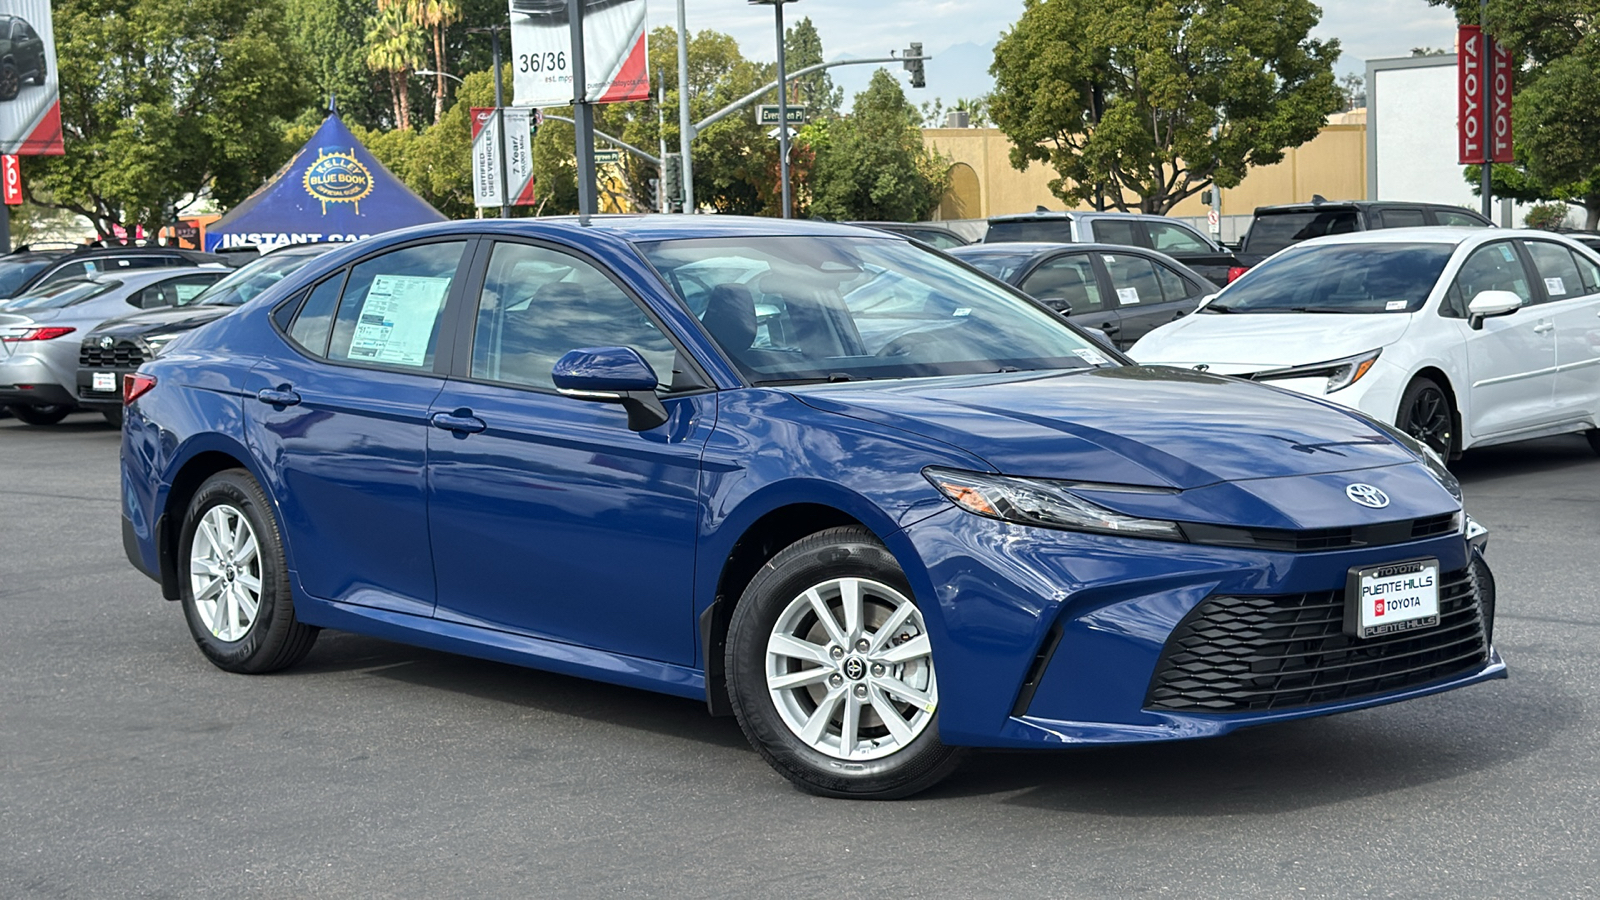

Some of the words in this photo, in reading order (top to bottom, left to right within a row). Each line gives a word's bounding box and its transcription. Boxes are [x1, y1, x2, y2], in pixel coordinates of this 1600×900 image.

[520, 51, 566, 73] 36/36
[545, 75, 557, 83] est.
[558, 74, 573, 84] mpg
[1465, 35, 1477, 157] TOYOTA
[1495, 39, 1507, 155] TOYOTA
[763, 110, 795, 120] Everen
[795, 110, 803, 120] Pl
[486, 130, 494, 171] VEHICLES
[511, 135, 519, 164] Year/
[316, 158, 362, 173] KELLEY
[6, 154, 18, 199] TOY
[310, 173, 337, 185] BLUE
[338, 173, 366, 185] BOOK
[222, 233, 322, 248] INSTANT
[1380, 563, 1420, 577] TOYOTA
[1362, 581, 1402, 597] PUENTE
[1403, 576, 1433, 591] HILLS
[1386, 596, 1421, 611] TOYOTA
[1365, 622, 1406, 636] PUENTE
[1406, 616, 1436, 630] HILLS
